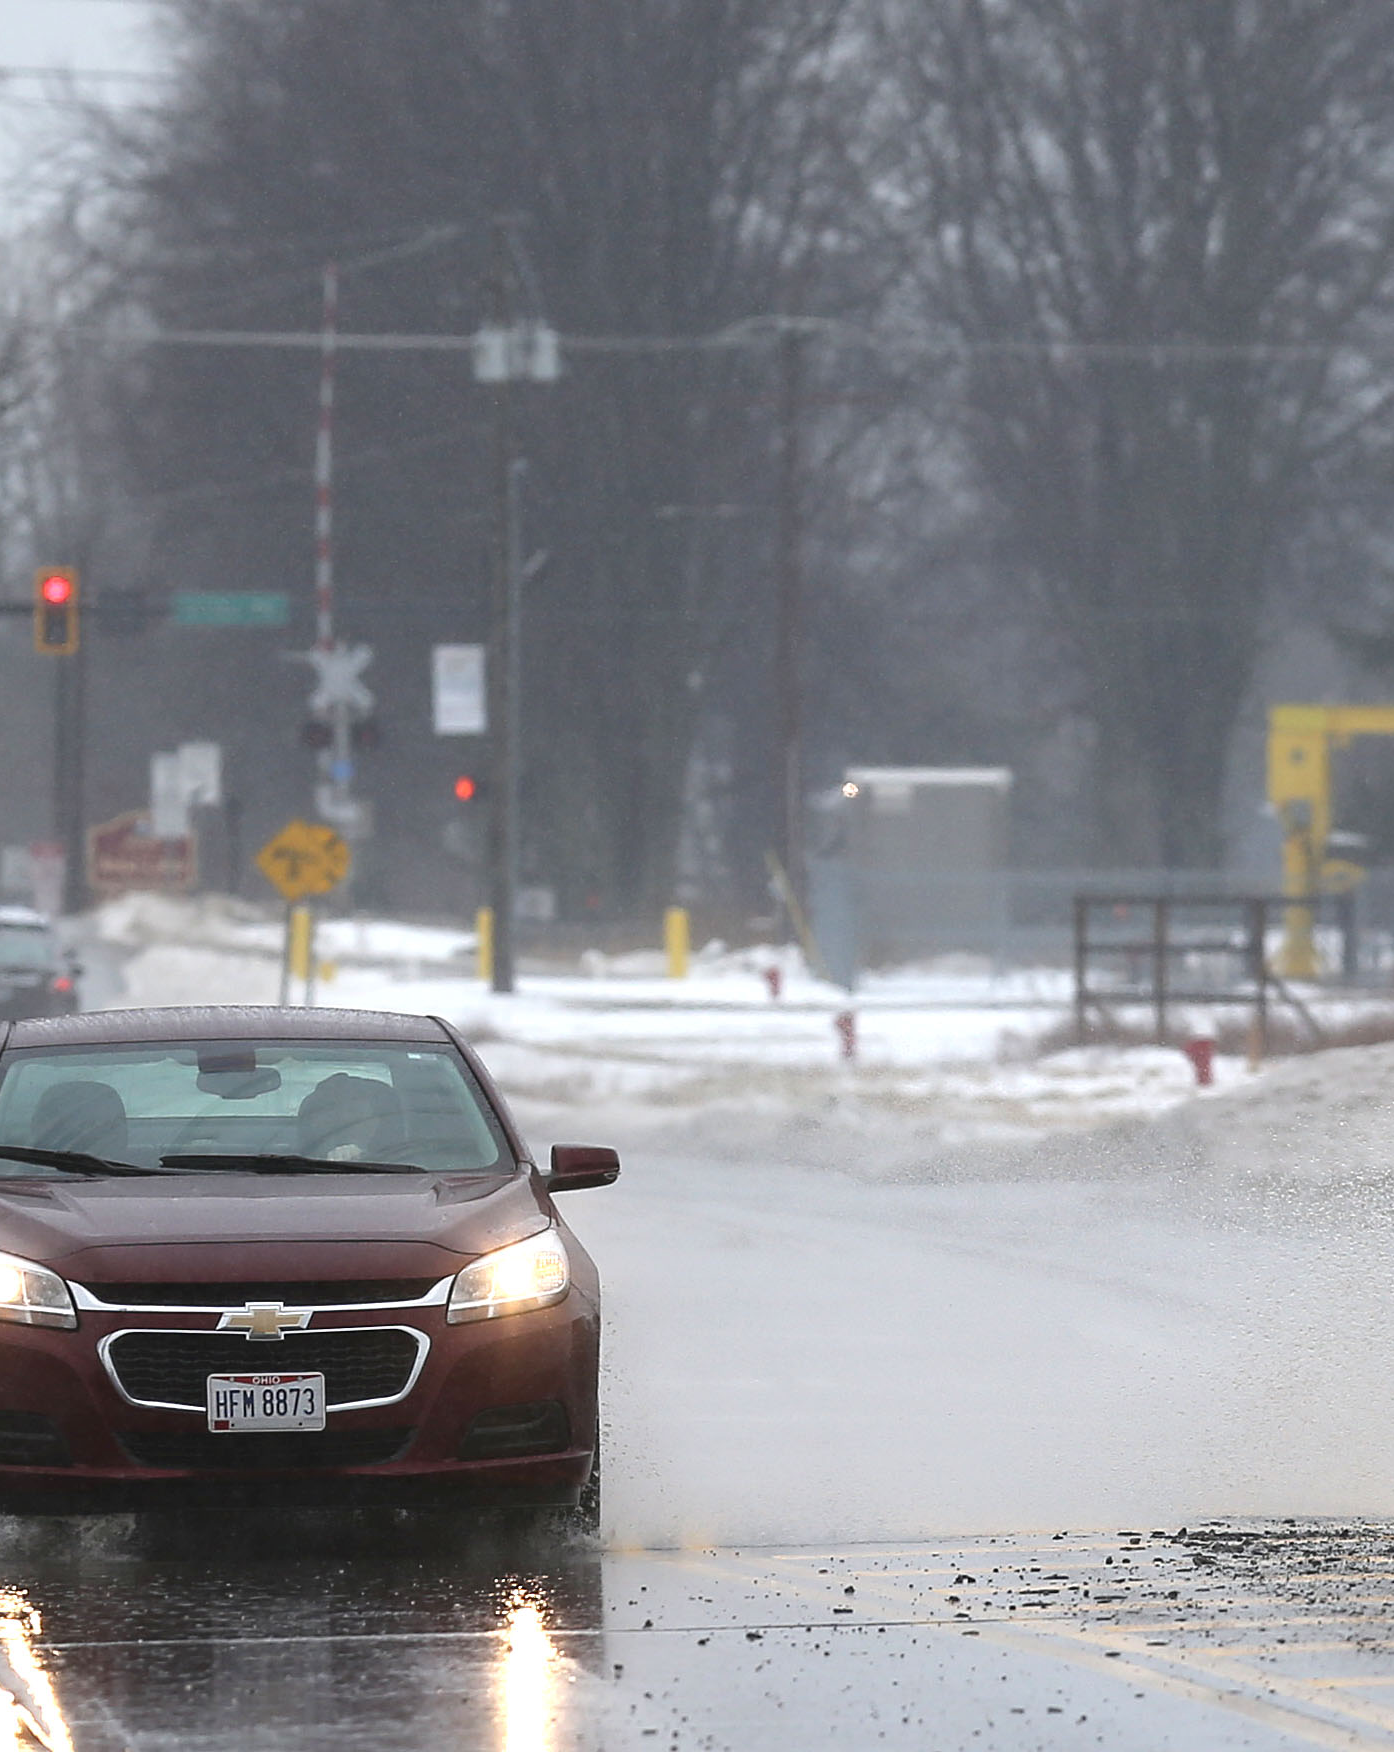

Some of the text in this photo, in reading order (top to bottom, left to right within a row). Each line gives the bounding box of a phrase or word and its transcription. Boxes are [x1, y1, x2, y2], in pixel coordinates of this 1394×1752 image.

[252, 1376, 281, 1385] OHIO
[215, 1387, 315, 1418] HFM 8873
